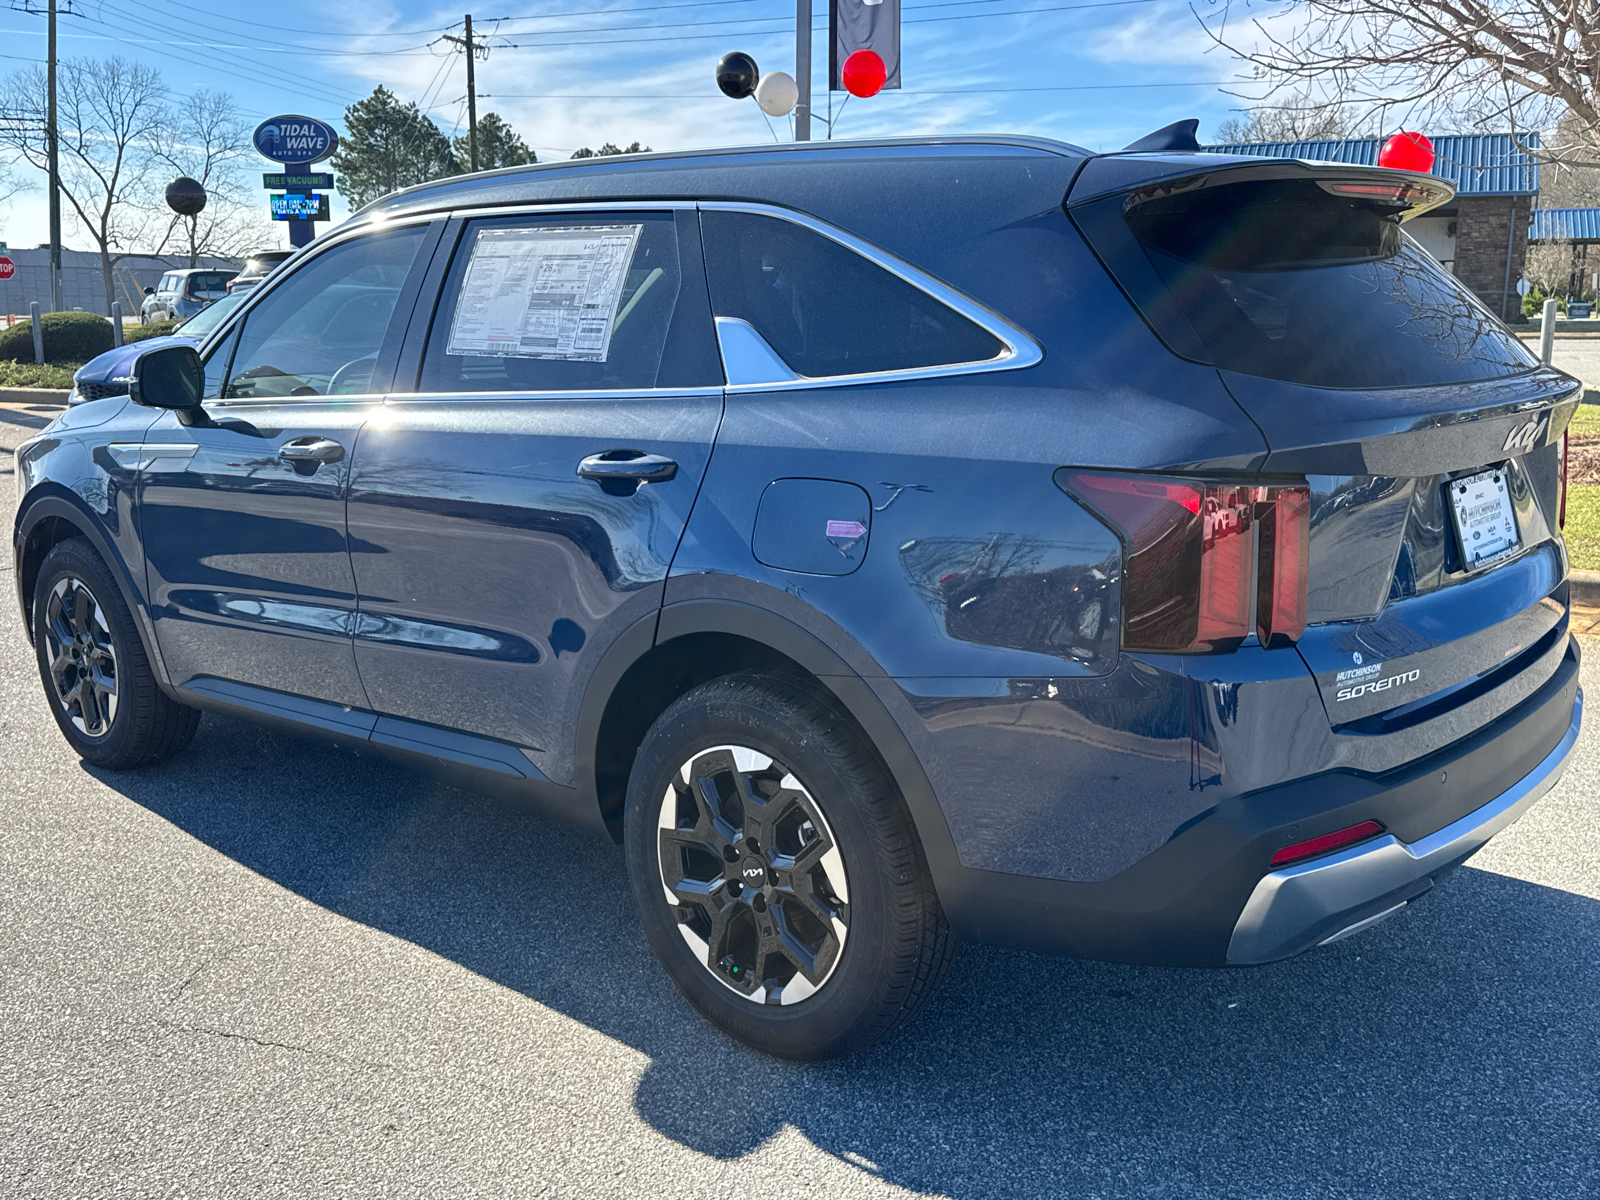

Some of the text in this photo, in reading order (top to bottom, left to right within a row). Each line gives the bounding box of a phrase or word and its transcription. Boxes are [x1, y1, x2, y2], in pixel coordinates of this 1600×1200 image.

[280, 124, 316, 136] TIDAL
[286, 137, 324, 149] WAVE
[266, 176, 323, 185] FREE VACUUMS
[0, 263, 14, 273] TOP
[543, 263, 553, 273] 26
[1336, 663, 1382, 682] HUTCHINSON
[1337, 669, 1420, 702] SORENTO
